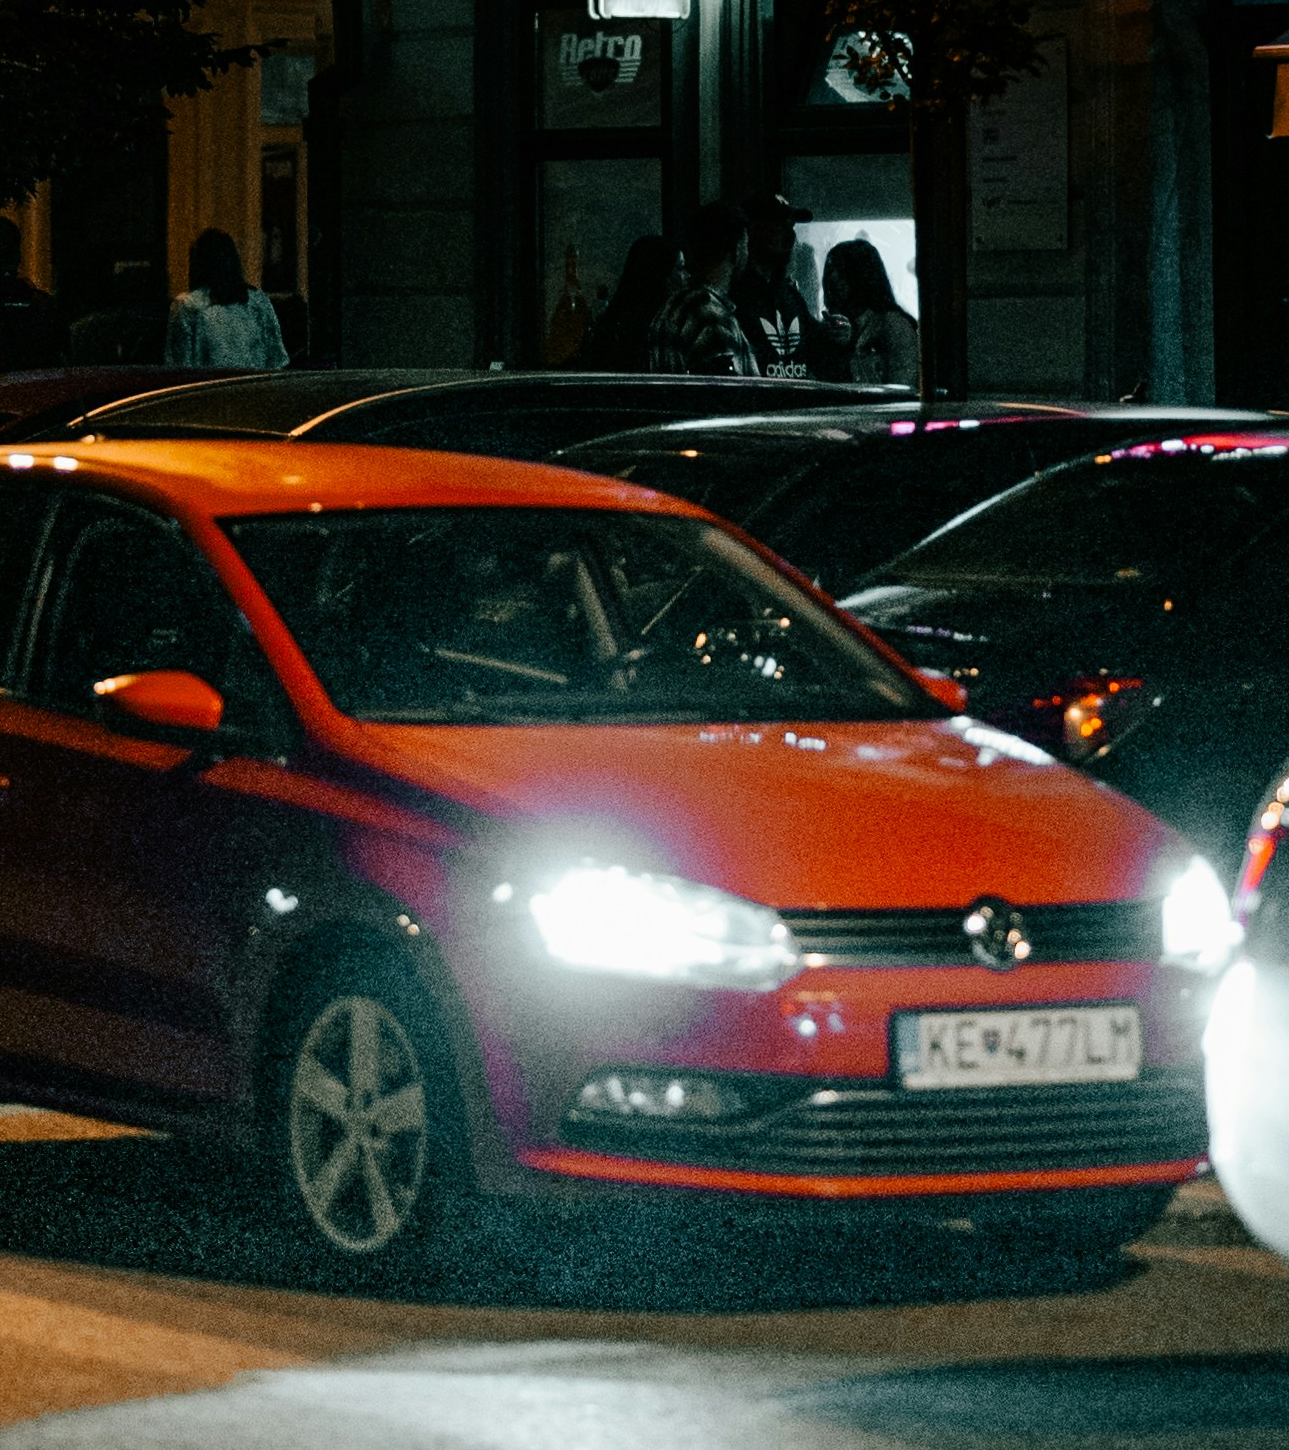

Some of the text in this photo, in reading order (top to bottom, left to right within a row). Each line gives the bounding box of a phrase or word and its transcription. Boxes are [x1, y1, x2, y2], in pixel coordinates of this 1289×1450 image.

[560, 30, 643, 64] Retro
[766, 361, 807, 378] adidas
[926, 1018, 979, 1072] KE
